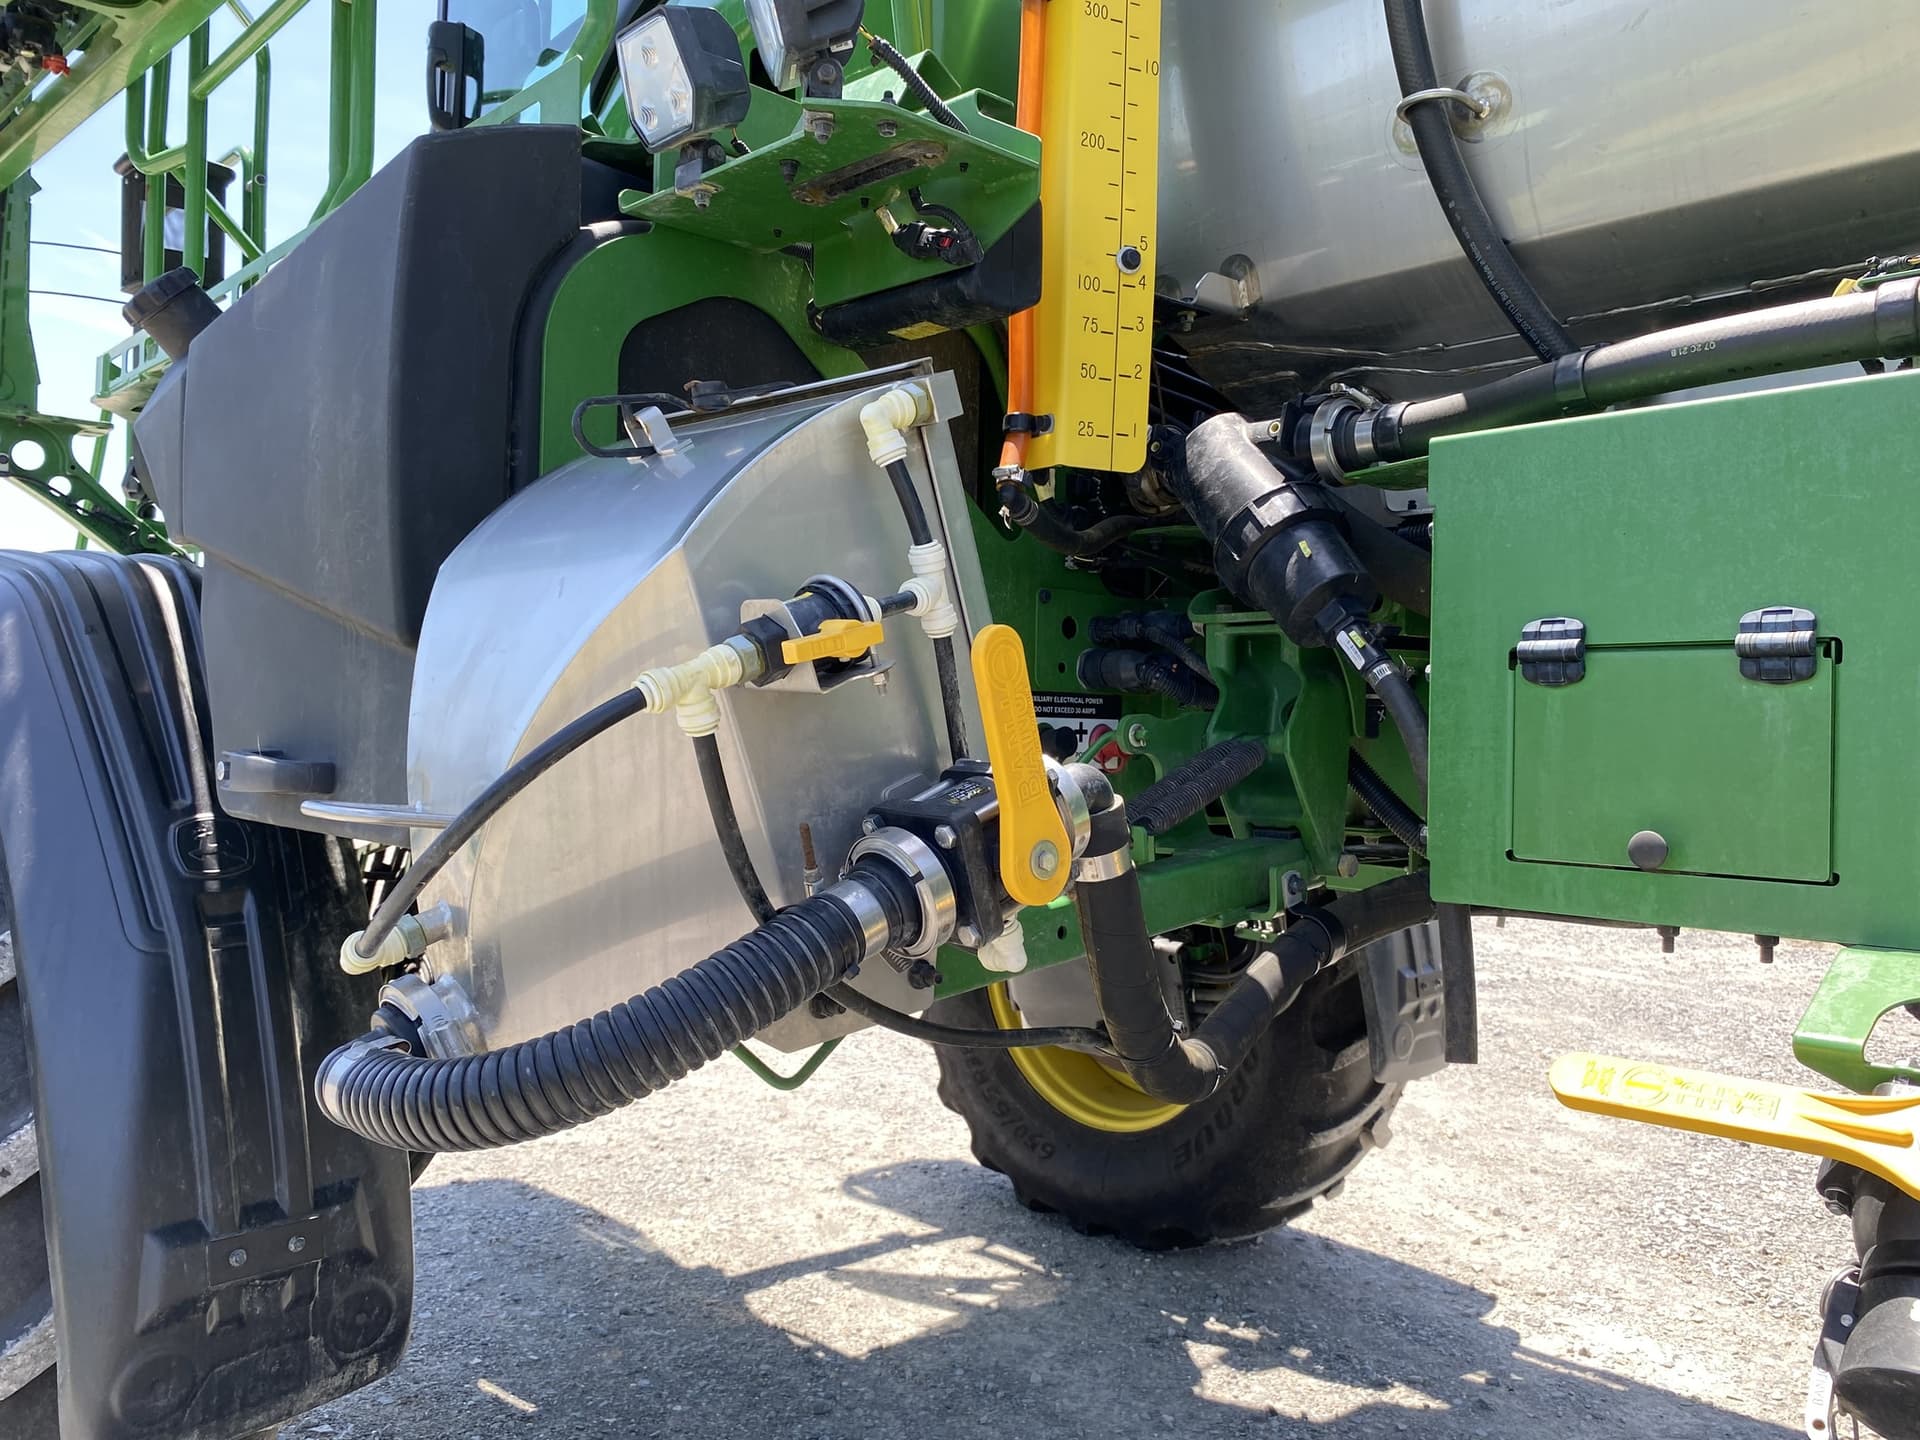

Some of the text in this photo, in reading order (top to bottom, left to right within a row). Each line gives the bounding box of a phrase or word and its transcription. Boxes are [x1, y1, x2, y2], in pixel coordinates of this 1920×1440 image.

[1085, 1, 1109, 20] 300
[1145, 59, 1159, 76] 10
[1081, 131, 1105, 150] 200
[1140, 236, 1148, 251] 5
[1078, 274, 1101, 292] 100
[1138, 275, 1147, 290] 4
[1082, 316, 1099, 333] 75
[1136, 316, 1145, 332] 3
[1080, 363, 1097, 379] 50
[1134, 364, 1142, 379] 2
[1078, 421, 1094, 437] 25
[1132, 424, 1137, 438] 1
[1054, 696, 1085, 705] ELECTRICAL
[1085, 697, 1104, 705] POWER
[1054, 706, 1075, 714] EXCEED
[1082, 707, 1097, 715] AMPS
